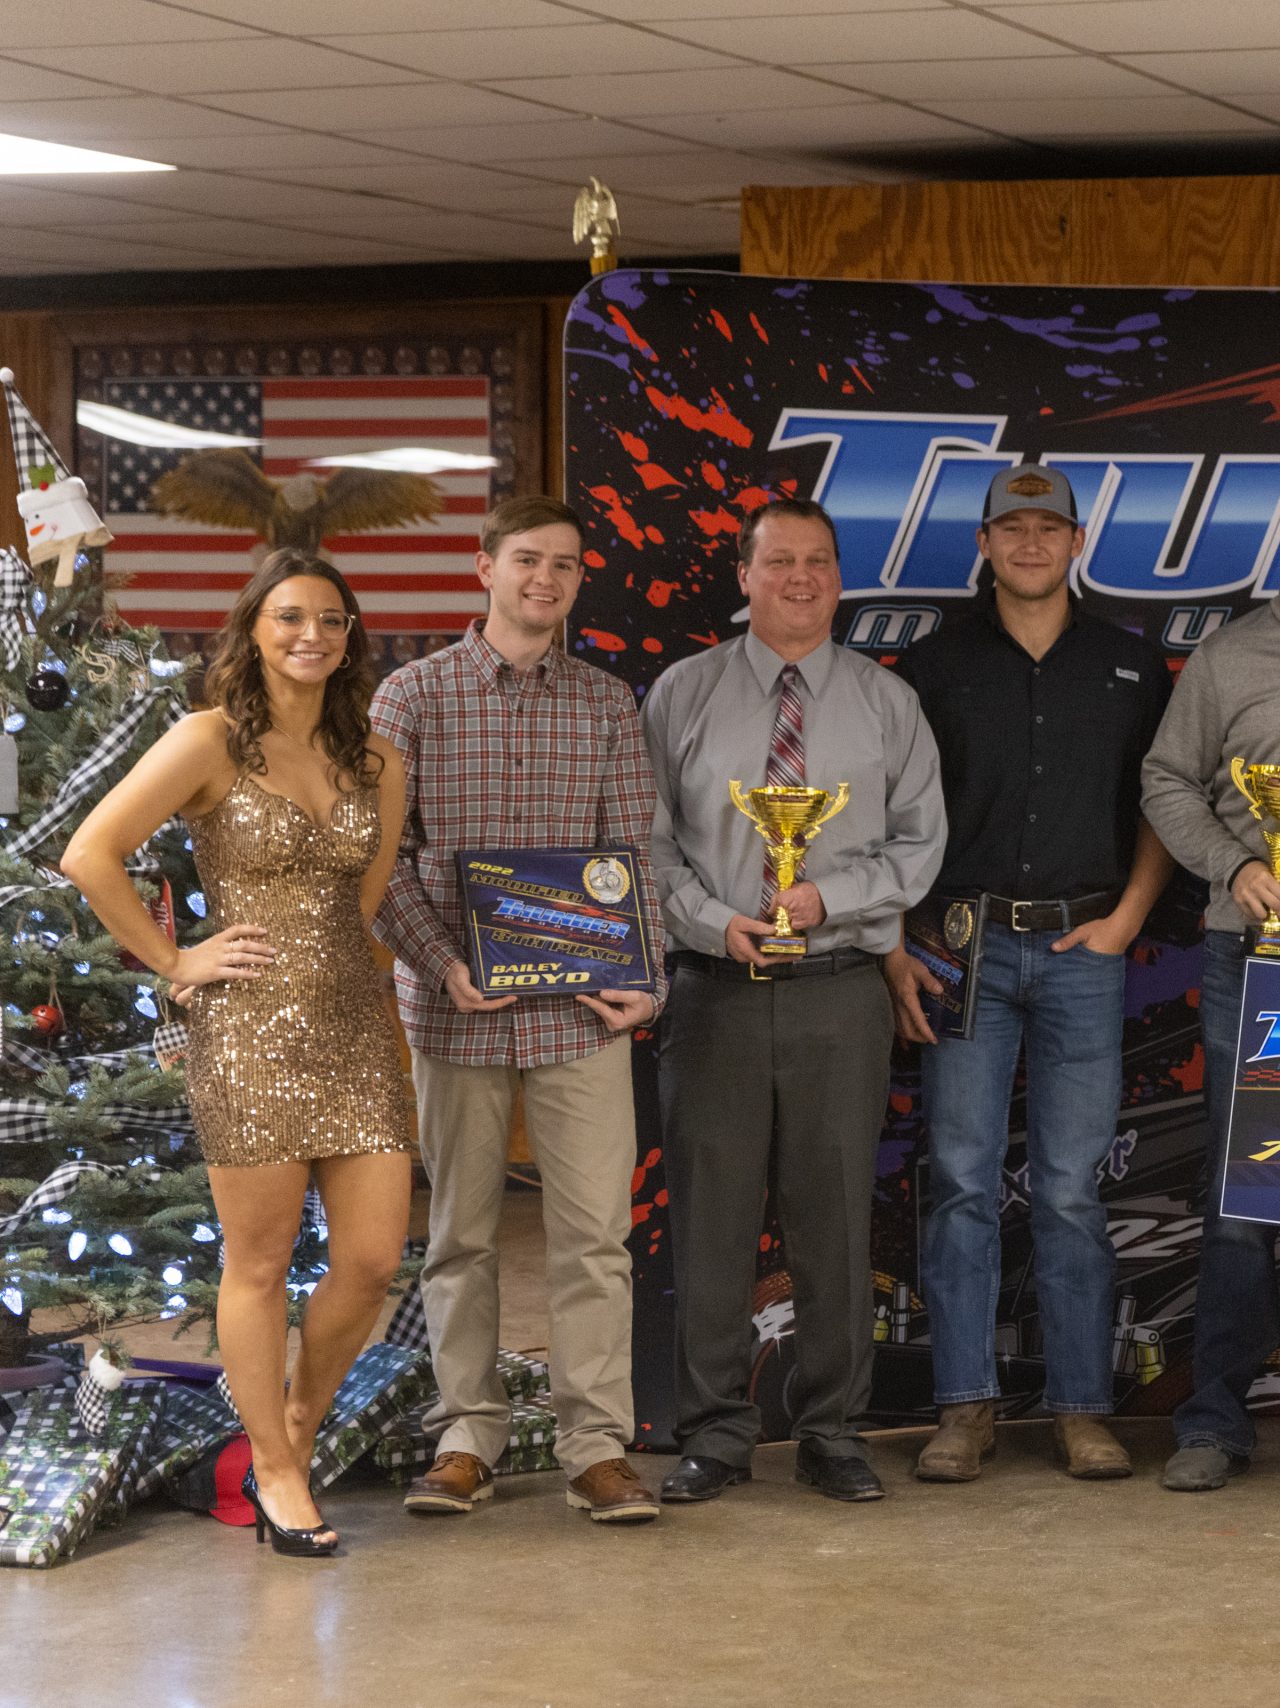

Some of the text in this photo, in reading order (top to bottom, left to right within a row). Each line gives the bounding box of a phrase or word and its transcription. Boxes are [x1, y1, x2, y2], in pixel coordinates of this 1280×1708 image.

[468, 862, 514, 876] 2022
[470, 872, 584, 903] MODIFIED
[492, 897, 630, 940] THUNDER
[548, 938, 633, 966] PLACE
[489, 971, 591, 987] BOYD
[491, 962, 562, 974] BAILEY
